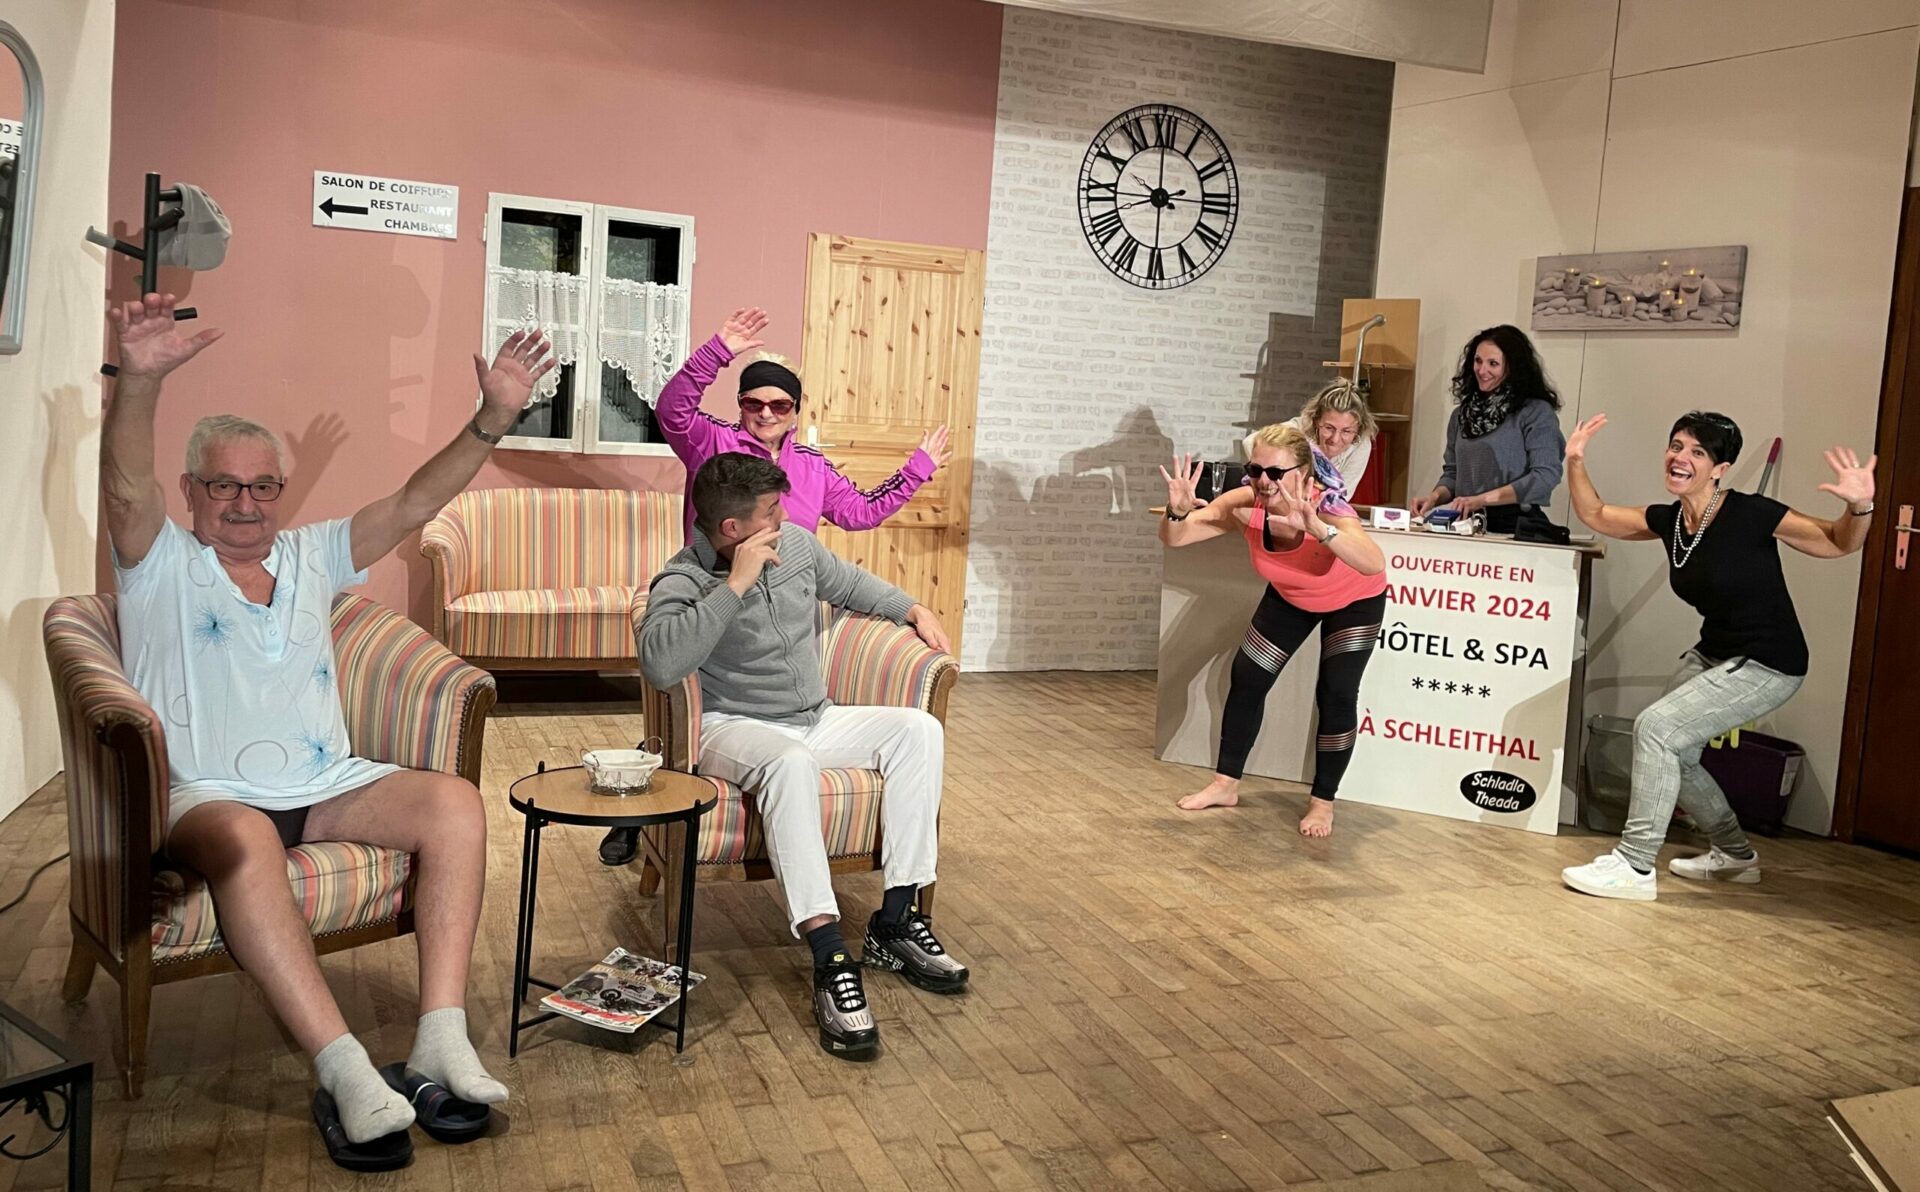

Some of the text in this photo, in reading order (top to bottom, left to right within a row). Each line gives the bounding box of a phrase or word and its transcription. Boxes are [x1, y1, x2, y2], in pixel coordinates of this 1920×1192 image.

[321, 175, 364, 189] SALON
[369, 180, 386, 192] DE
[370, 199, 454, 217] RESTAURANT
[384, 218, 453, 235] CHAMBRES
[1390, 554, 1535, 583] OUVERTURE EN
[1385, 583, 1552, 621] ANVIER 2024
[1375, 621, 1549, 670] HÔTEL & SPA
[1358, 707, 1541, 761] À SCHLEITHAL
[1471, 772, 1526, 793] Schladla
[1474, 790, 1521, 811] Theada
